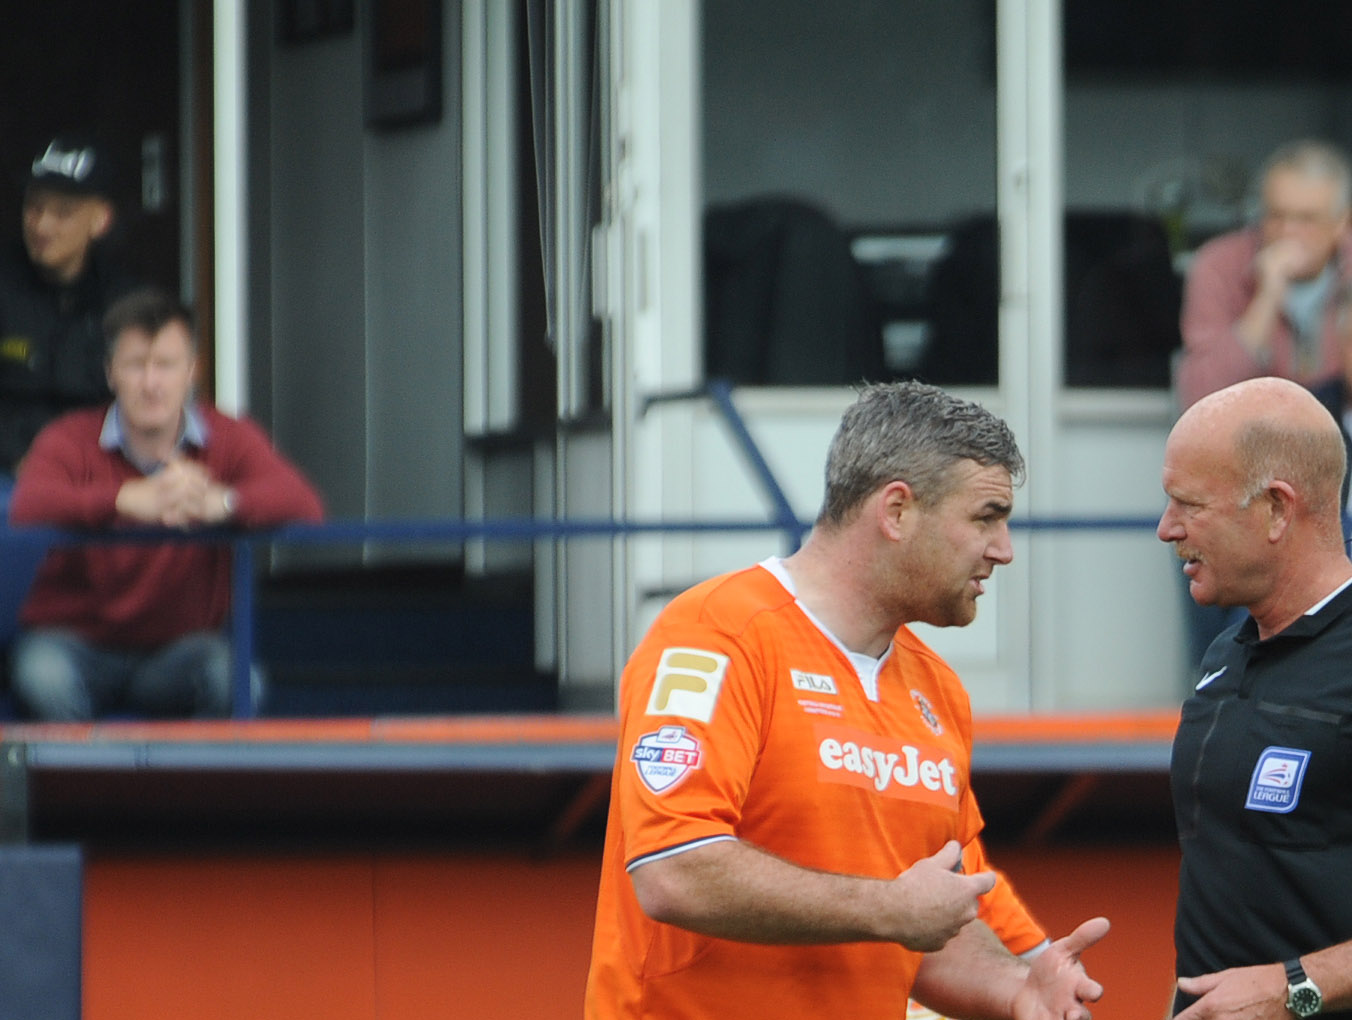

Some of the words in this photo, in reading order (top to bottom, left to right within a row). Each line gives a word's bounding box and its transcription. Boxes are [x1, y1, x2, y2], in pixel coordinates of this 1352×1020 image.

[797, 674, 832, 691] FILA
[634, 746, 661, 761] sky
[663, 750, 698, 766] BET
[819, 738, 957, 796] easyJet
[1253, 790, 1290, 803] LEAGUE
